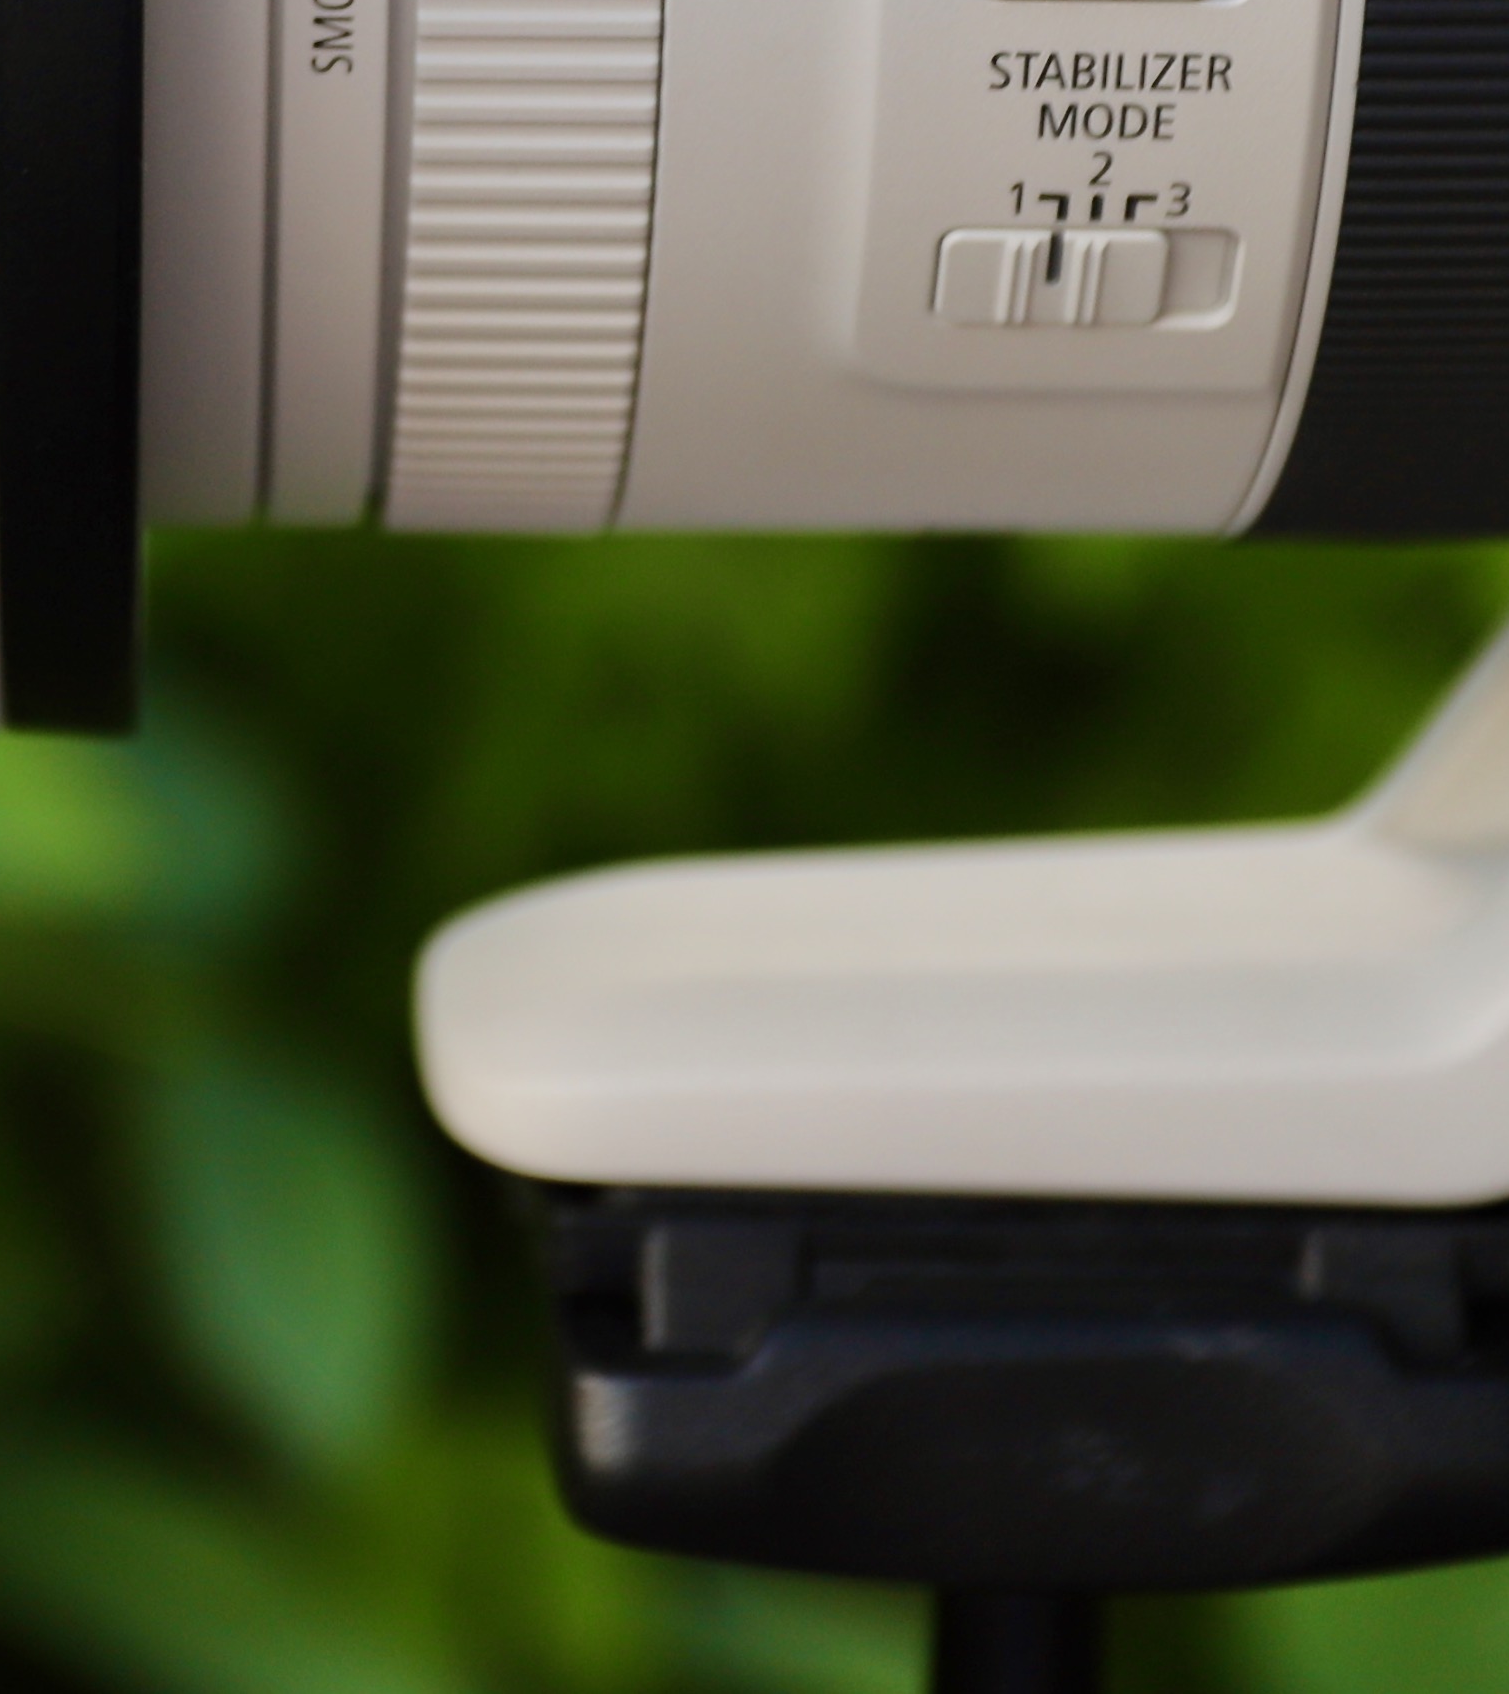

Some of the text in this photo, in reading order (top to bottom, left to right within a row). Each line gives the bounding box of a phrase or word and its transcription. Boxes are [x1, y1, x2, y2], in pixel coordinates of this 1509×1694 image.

[989, 51, 1232, 92] STABILIZER
[1037, 102, 1177, 141] MODE
[1088, 151, 1114, 187] 2
[1009, 181, 1025, 216] 1
[1164, 182, 1193, 218] 3
